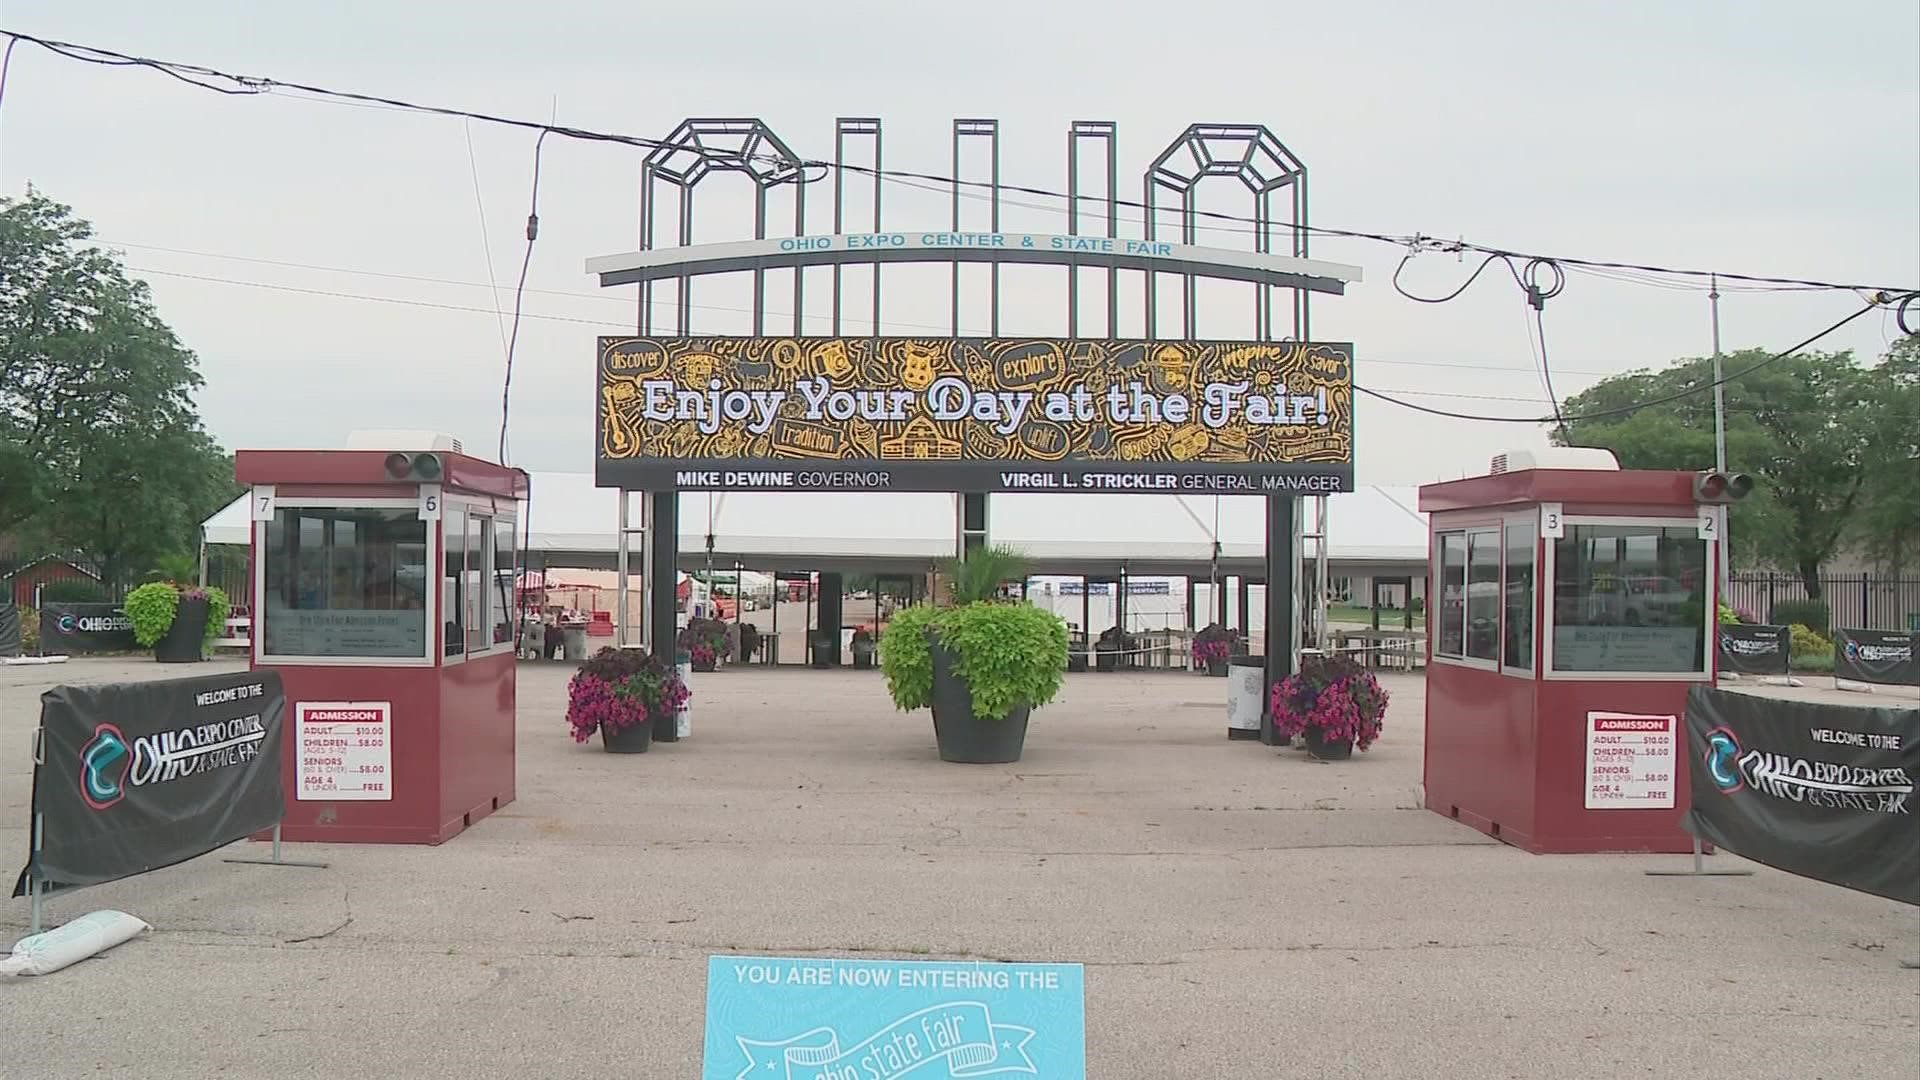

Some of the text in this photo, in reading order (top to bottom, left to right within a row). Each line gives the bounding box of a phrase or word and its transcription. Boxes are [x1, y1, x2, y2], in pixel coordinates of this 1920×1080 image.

[780, 234, 1172, 256] OHIO EXPO CENTER & STATE FAIR
[610, 350, 661, 369] discover
[1002, 350, 1057, 381] explore
[1222, 343, 1281, 370] inspire
[1310, 354, 1342, 374] savor
[642, 376, 1329, 434] Enjoy Your Day at the Fair!
[781, 423, 834, 452] tradition
[1026, 425, 1058, 450] uplift
[676, 471, 890, 487] MIKE DEWINE GOVERNOR
[1001, 473, 1341, 490] VIRGIL L. STRICKLER GENERAL MANAGER
[259, 497, 270, 512] 7
[426, 496, 437, 512] 6
[1548, 514, 1558, 529] 3
[1704, 517, 1713, 532] 2
[79, 617, 112, 632] OHIO
[196, 684, 263, 706] WELCOME TO THE
[310, 711, 377, 721] ADMISSION
[1601, 720, 1664, 730] ADMISSION
[304, 727, 333, 735] ADULT
[1594, 736, 1622, 744] ADULT
[1811, 728, 1901, 749] WELCOME TO THE
[130, 714, 265, 786] OHIO EXPO CENTER
[207, 746, 237, 770] STATE
[1594, 748, 1635, 756] CHILDREN
[1738, 750, 1913, 802] OHIO EXPO CENTER
[1807, 789, 1910, 814] & STATE FAIR
[735, 965, 1059, 989] YOU ARE NOW ENTERING THE
[862, 1031, 922, 1080] state
[921, 1012, 965, 1052] fair
